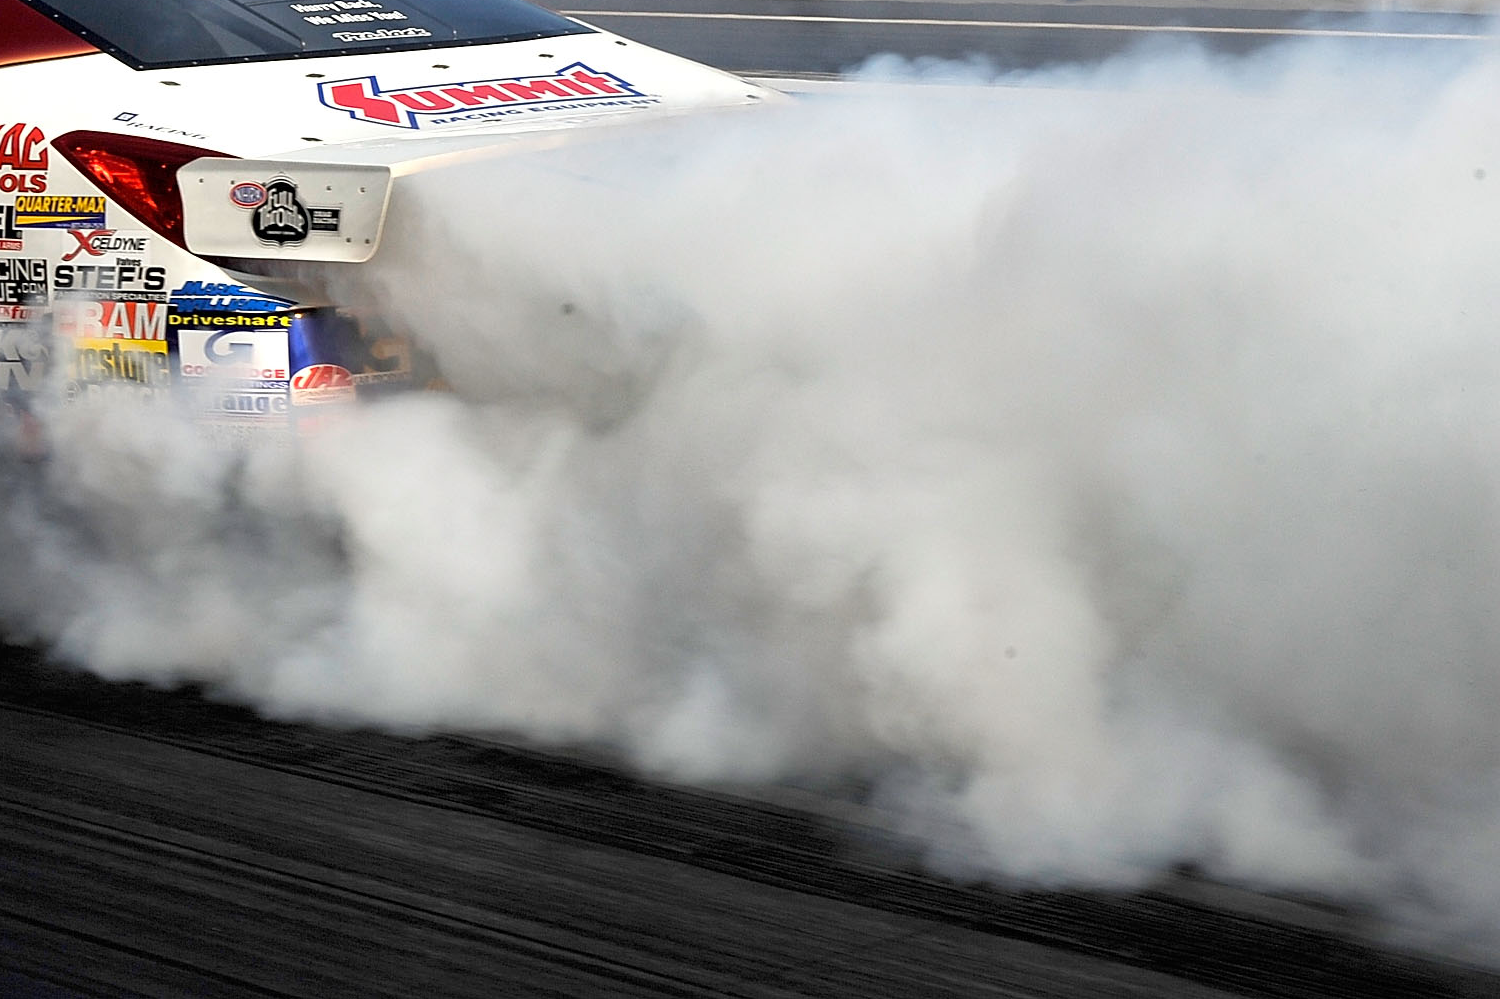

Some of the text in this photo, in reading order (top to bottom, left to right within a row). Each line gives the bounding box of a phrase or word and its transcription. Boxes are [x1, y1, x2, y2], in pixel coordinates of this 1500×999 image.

[330, 70, 623, 124] SUMMIT
[430, 109, 524, 126] RACING
[16, 196, 106, 213] QUARTER-MAX
[61, 229, 146, 262] XCELDYNE
[54, 264, 166, 291] STEF'S
[111, 291, 167, 302] SPECIALTIES
[64, 343, 171, 386] restone
